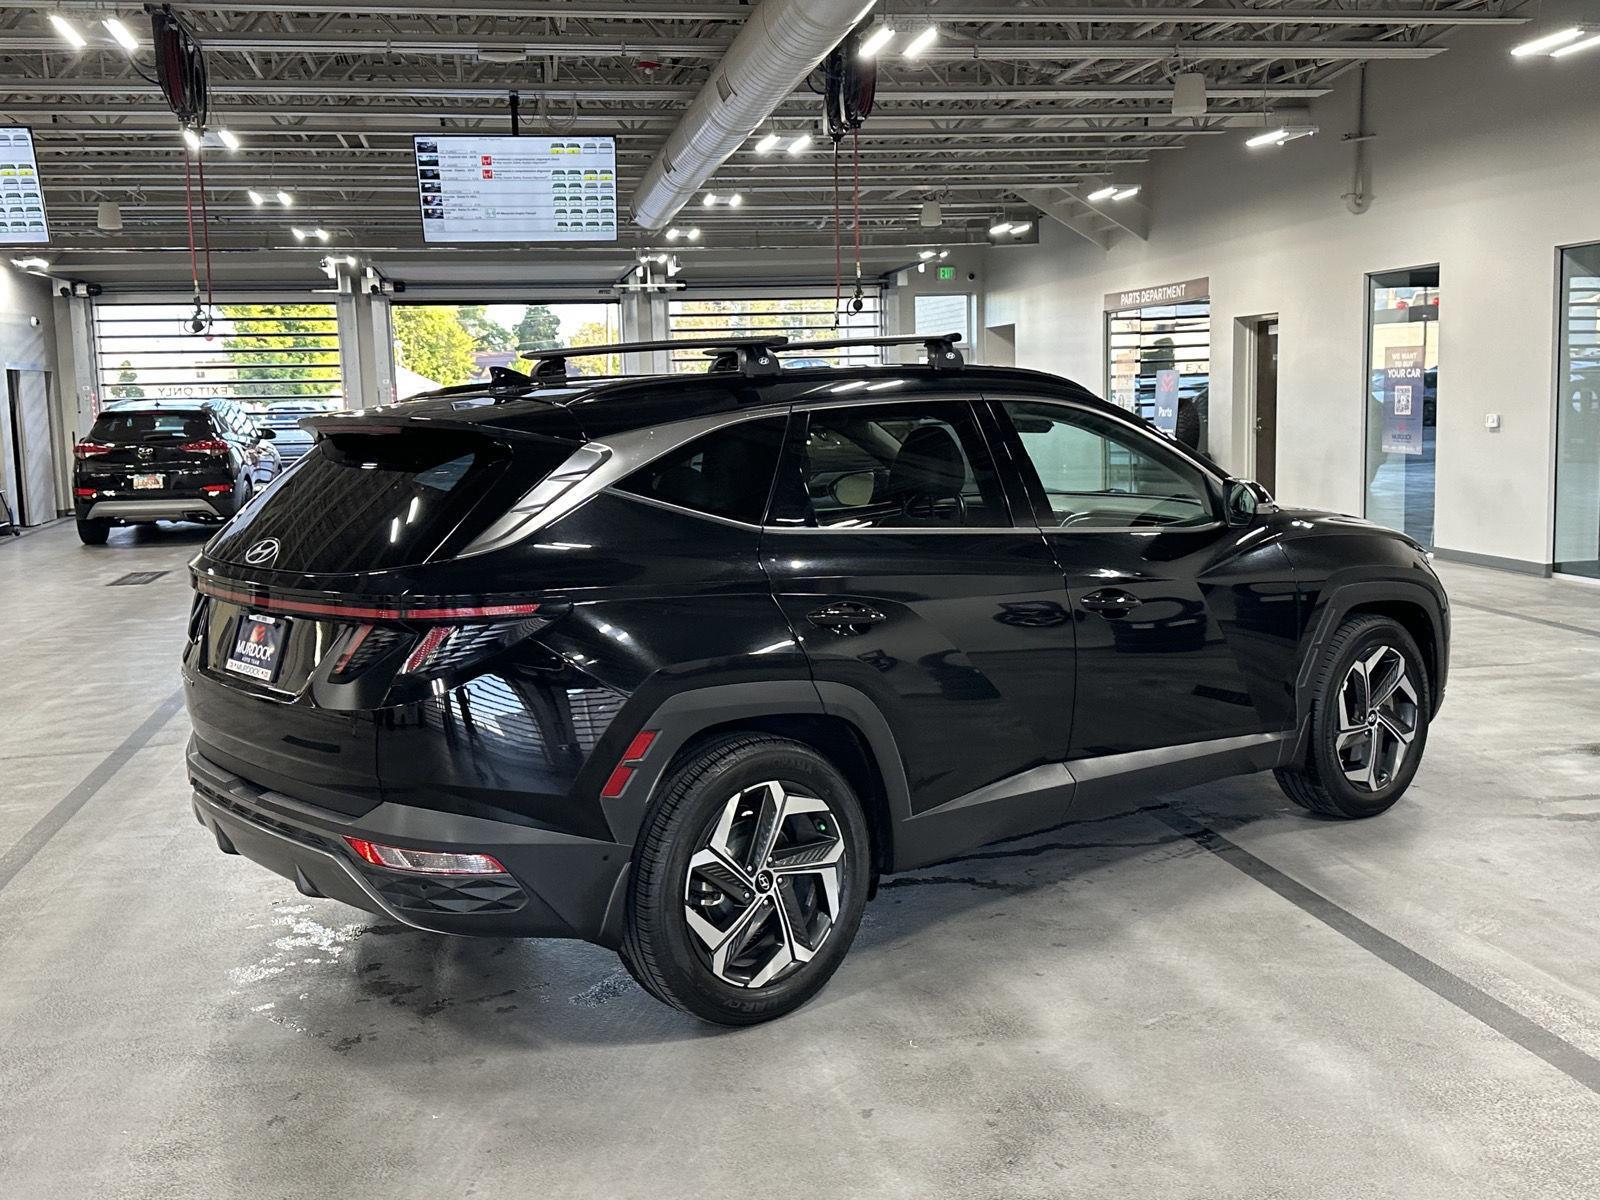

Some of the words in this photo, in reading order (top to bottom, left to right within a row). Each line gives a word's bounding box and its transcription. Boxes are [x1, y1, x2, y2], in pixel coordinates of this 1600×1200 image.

[939, 267, 954, 279] EXIT
[1120, 292, 1140, 306] PARTS
[1141, 284, 1186, 303] DEPARTMENT
[1391, 352, 1400, 360] WE
[1401, 352, 1417, 360] WANT
[1387, 368, 1405, 378] YOUR
[1406, 368, 1421, 378] CAR
[1158, 406, 1173, 418] Parts
[236, 640, 271, 661] MURDOCK
